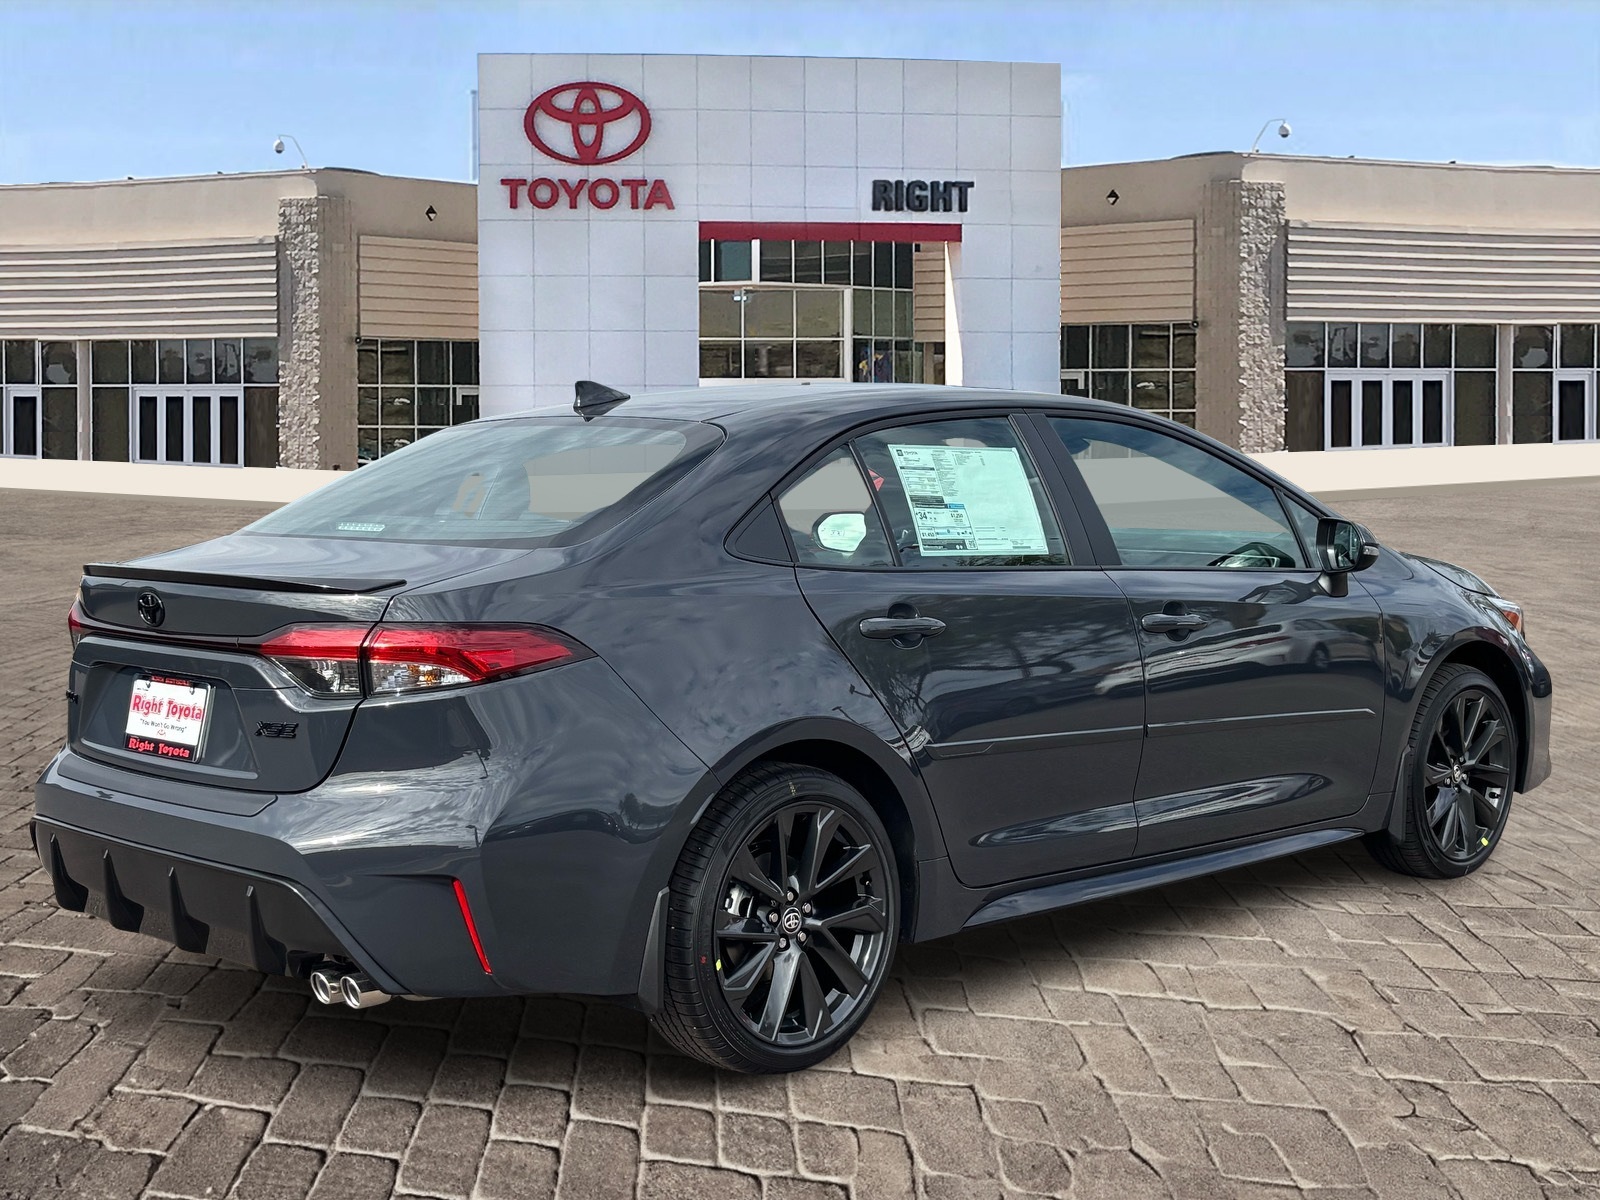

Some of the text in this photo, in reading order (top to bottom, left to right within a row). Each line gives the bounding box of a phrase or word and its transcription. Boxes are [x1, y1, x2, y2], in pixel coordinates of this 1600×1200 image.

[500, 177, 676, 210] TOYOTA
[871, 179, 975, 212] RIGHT
[132, 694, 204, 720] Right Toyota
[163, 722, 170, 730] Go
[128, 737, 190, 758] Right Toyota
